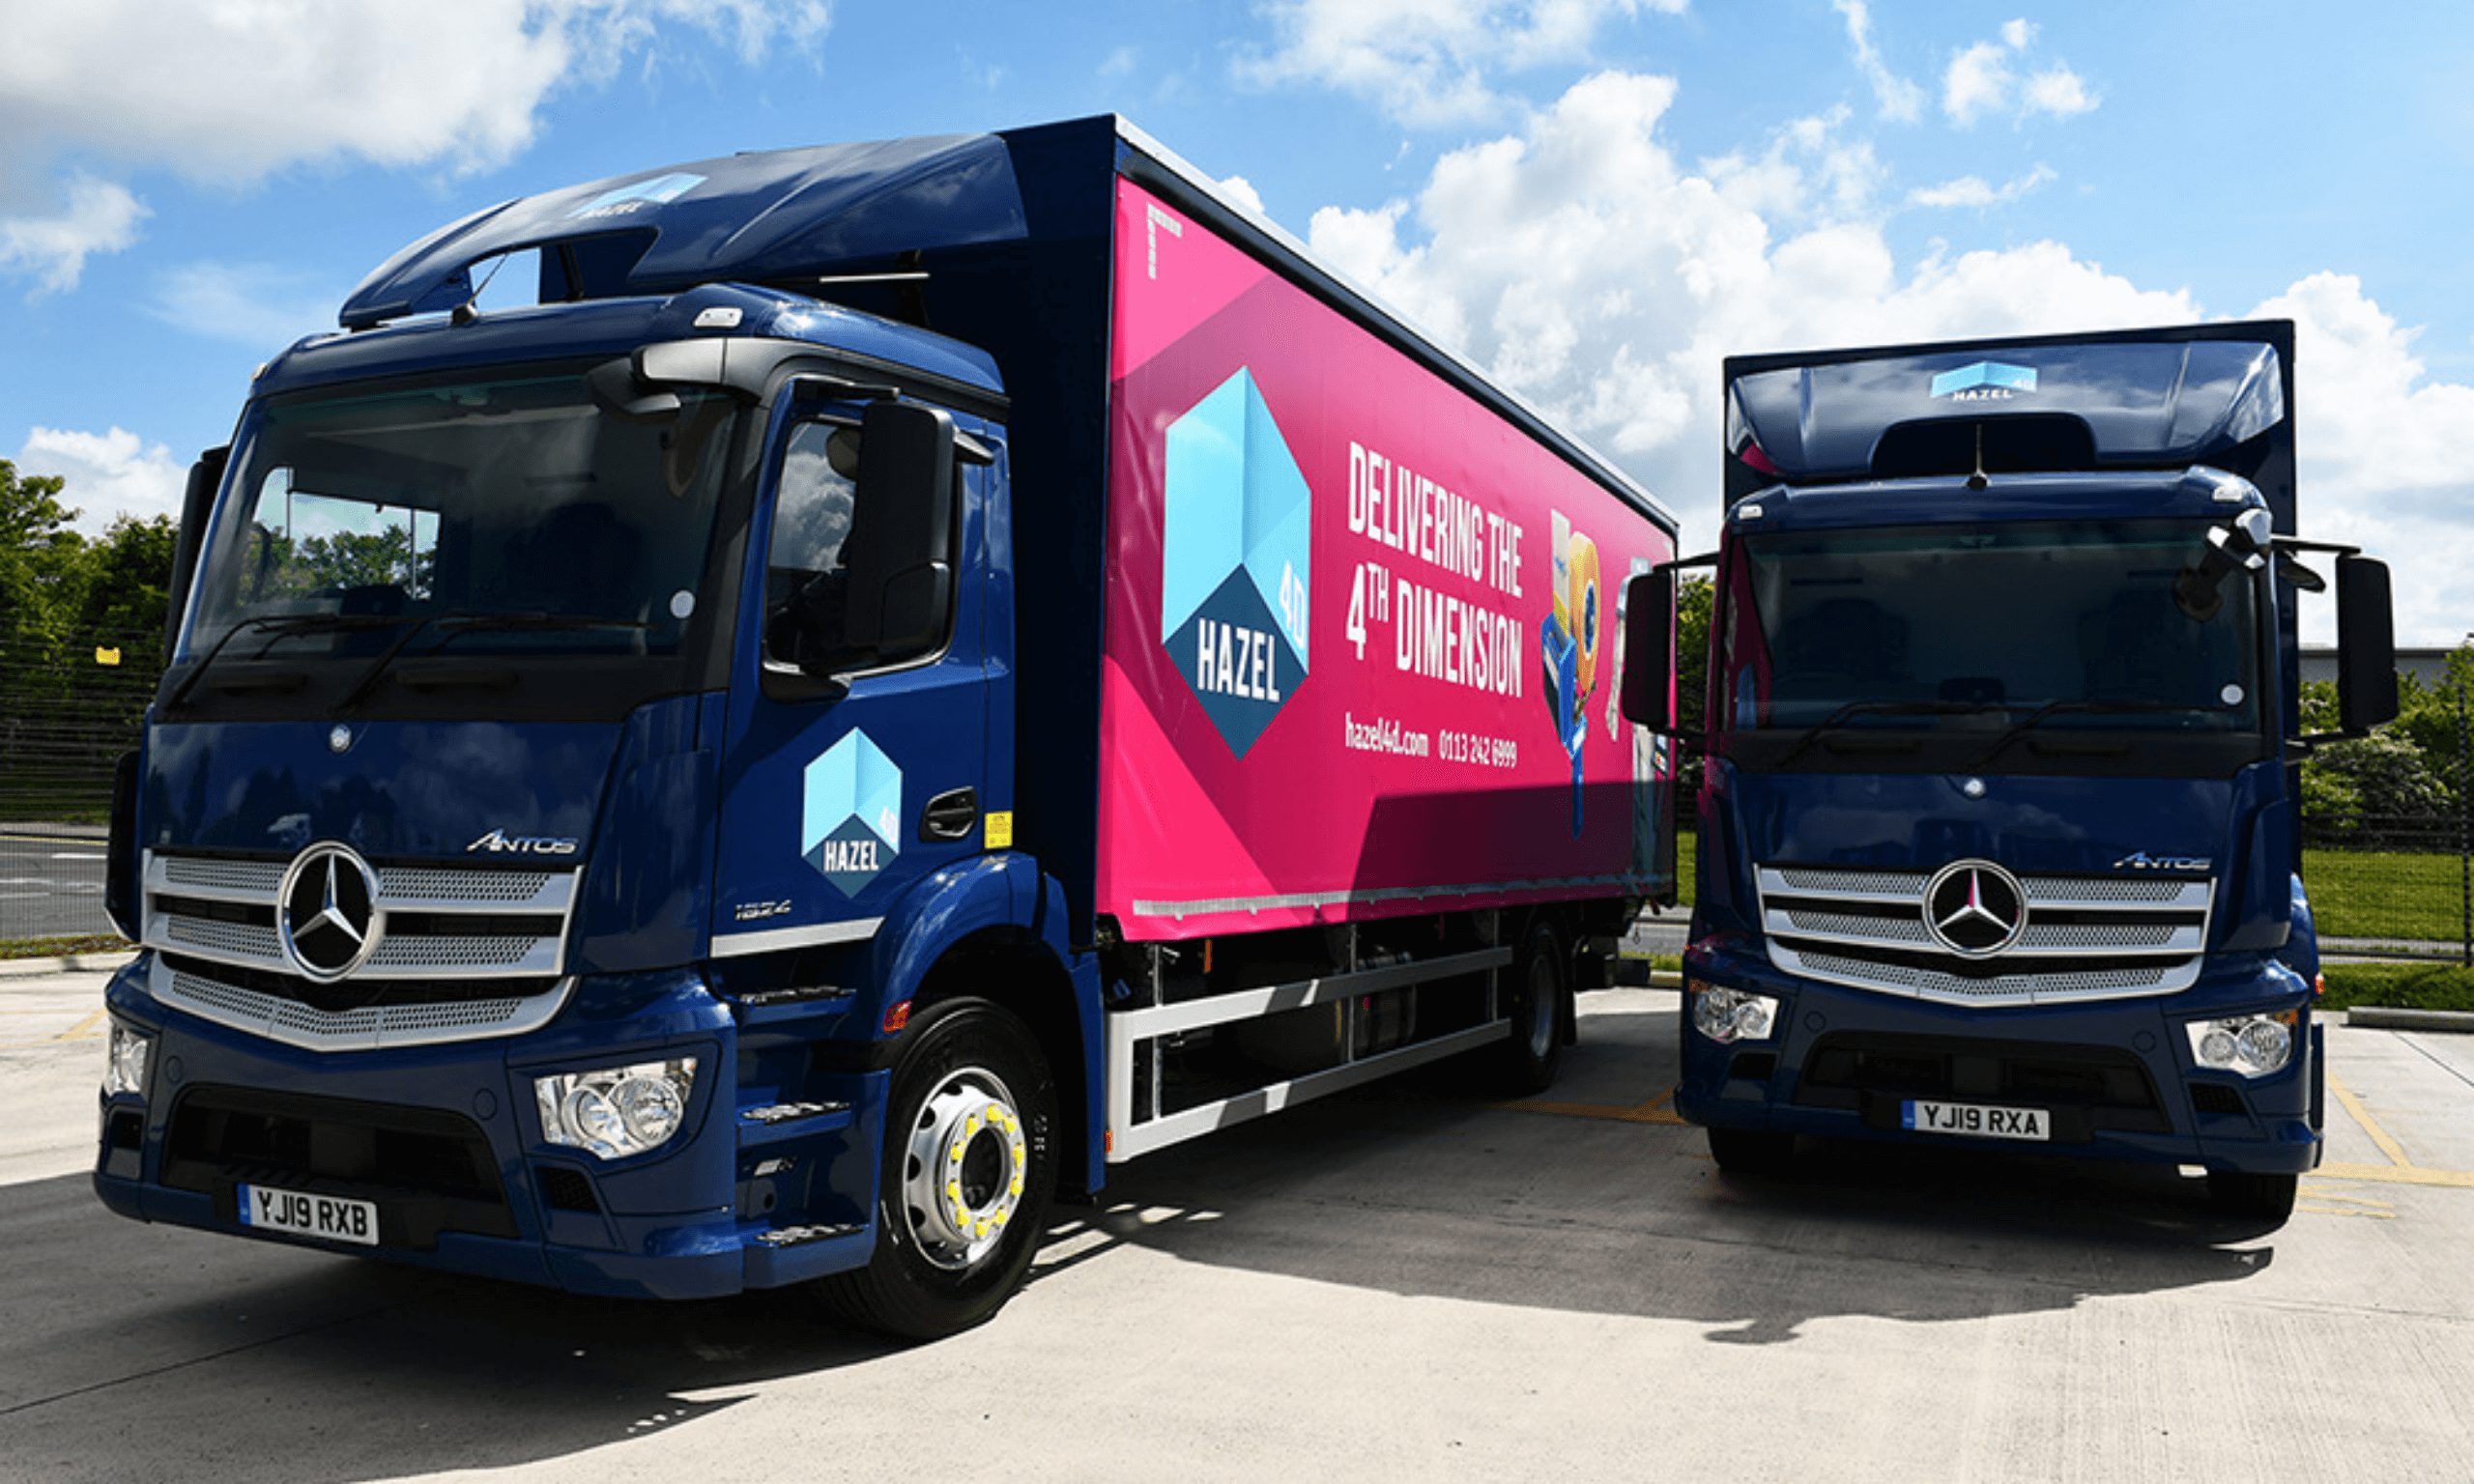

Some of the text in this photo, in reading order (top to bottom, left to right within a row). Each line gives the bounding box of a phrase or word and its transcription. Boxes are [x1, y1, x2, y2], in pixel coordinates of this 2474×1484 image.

[1953, 388, 2013, 401] HAZEL
[1348, 441, 1523, 599] DELIVERING THE
[1279, 558, 1306, 649] 4D
[1197, 617, 1280, 702] HAZEL
[1396, 578, 1522, 698] DIMENSION
[1345, 711, 1428, 757] hazel4d.com
[1439, 729, 1468, 762] 0113
[1470, 734, 1490, 765] 242
[823, 840, 879, 871] HAZEL
[1924, 1104, 2039, 1135] YJ19 RXA
[258, 1190, 367, 1237] YJ19 RXB
